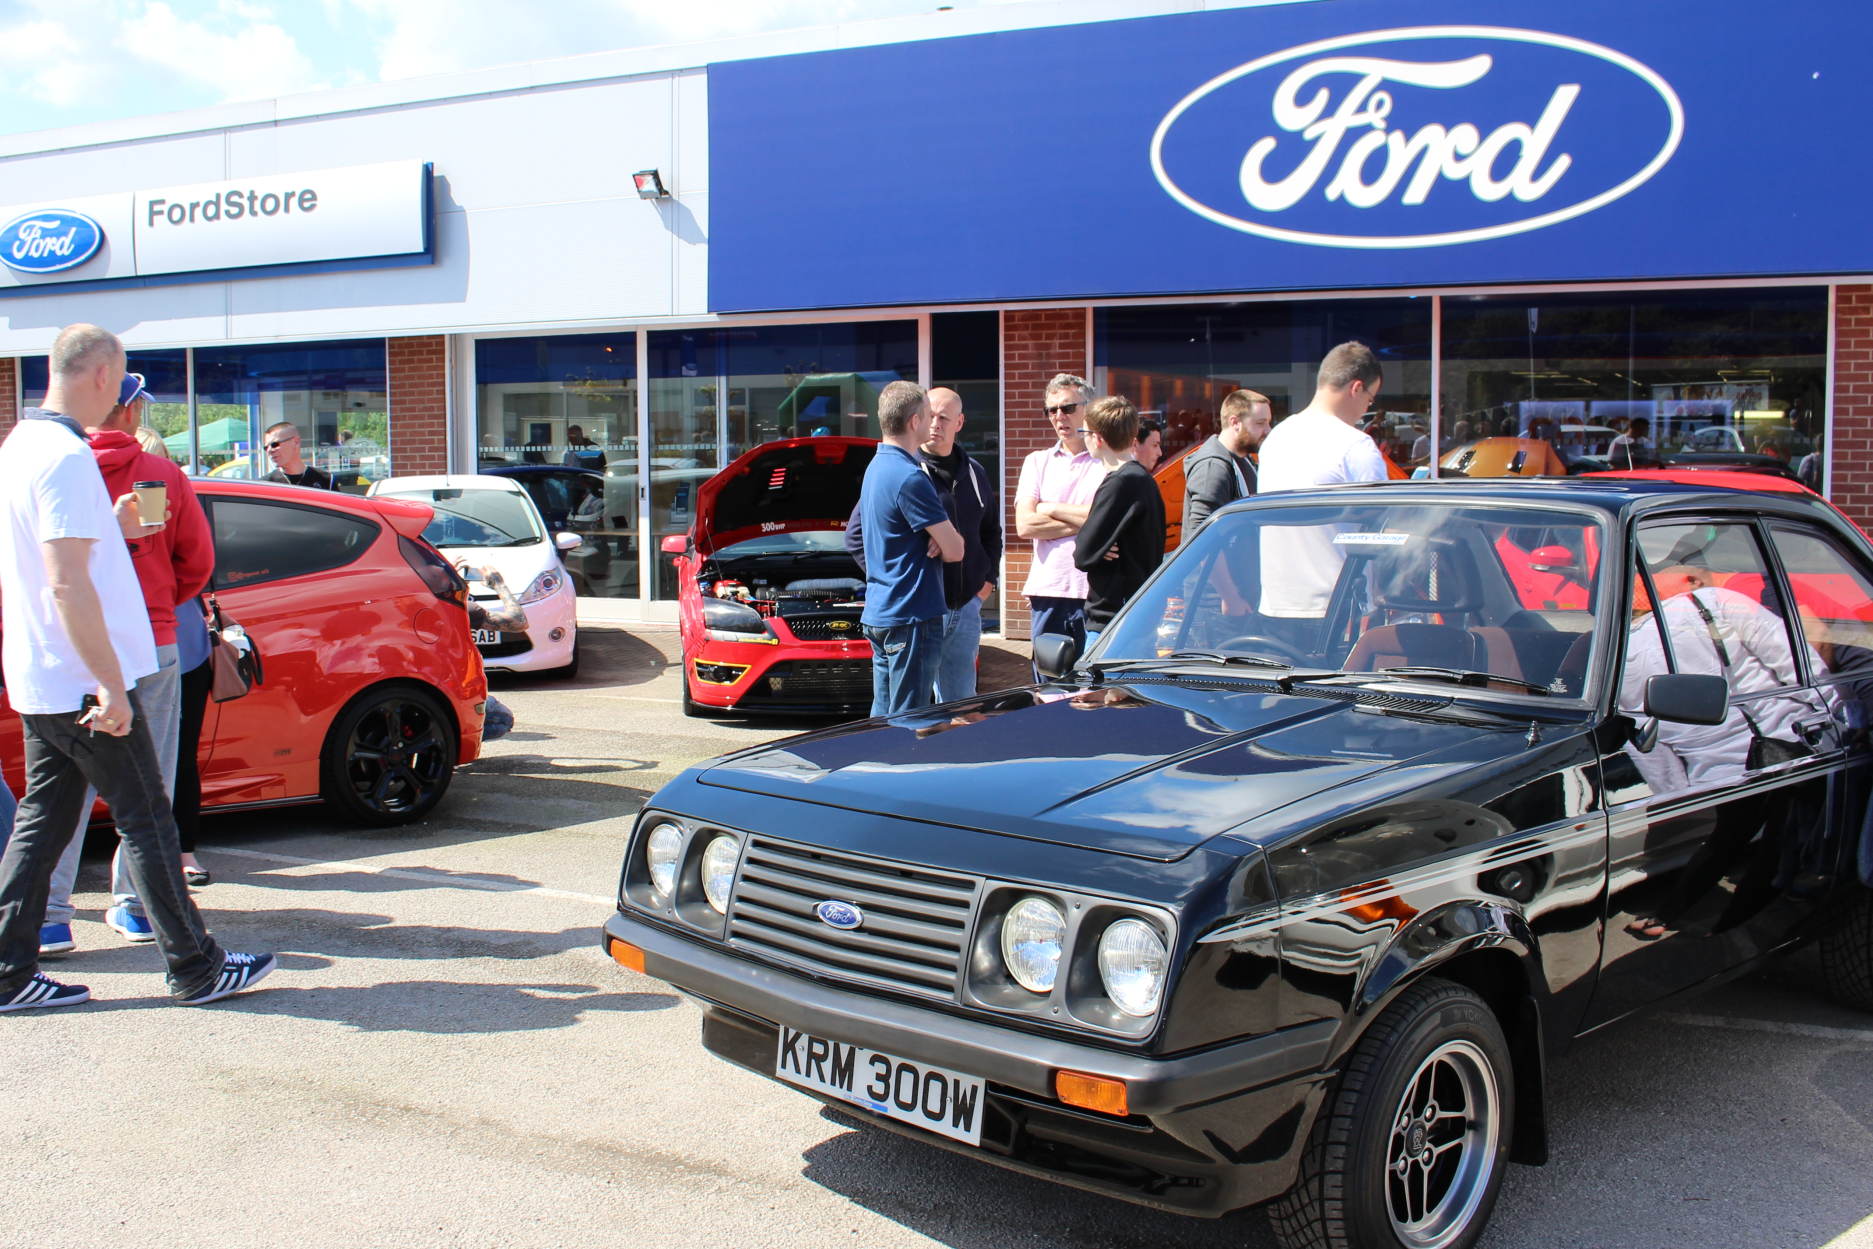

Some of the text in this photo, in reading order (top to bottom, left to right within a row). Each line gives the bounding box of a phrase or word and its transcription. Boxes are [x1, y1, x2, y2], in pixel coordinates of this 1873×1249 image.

[1239, 53, 1581, 213] Ford
[148, 188, 318, 228] FordStore
[11, 219, 77, 260] Ford
[1336, 533, 1370, 541] County
[1372, 533, 1407, 543] Garage
[825, 905, 850, 923] Ford
[780, 1026, 979, 1133] KRM 300W
